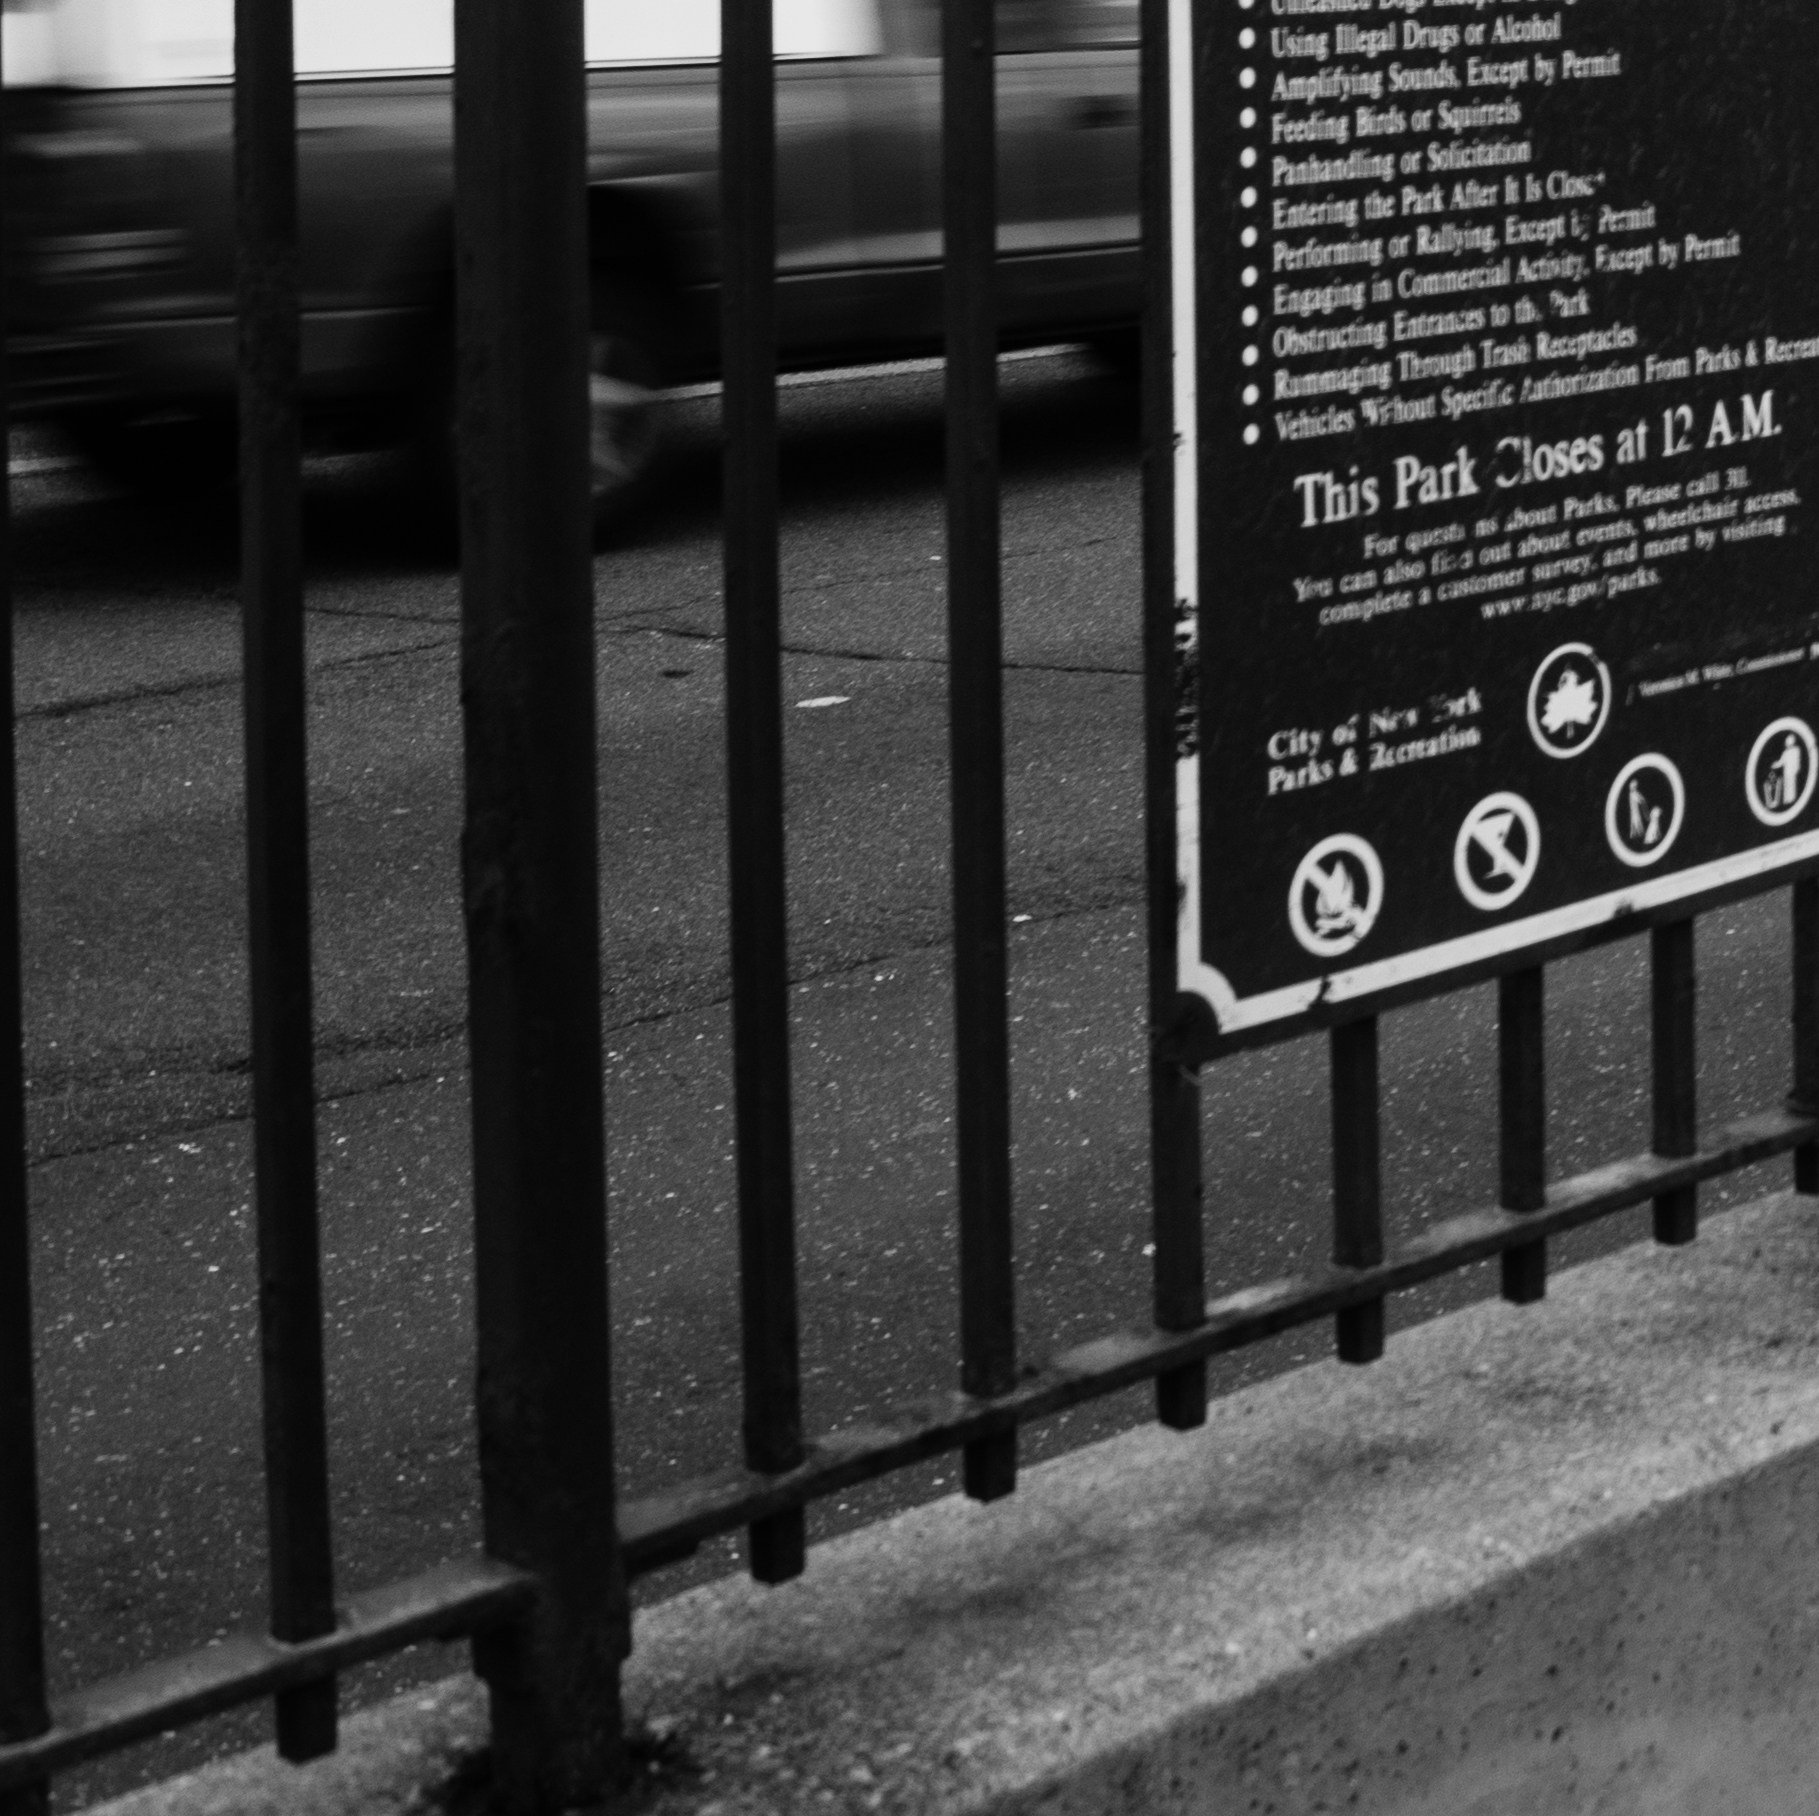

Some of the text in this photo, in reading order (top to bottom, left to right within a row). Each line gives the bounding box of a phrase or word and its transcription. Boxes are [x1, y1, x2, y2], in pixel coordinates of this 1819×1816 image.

[1270, 12, 1561, 60] Using Illegal Drugs or Alcohol
[1271, 96, 1521, 144] Feeding Birds or Squirrels
[1293, 465, 1379, 527] This
[1394, 445, 1479, 509] Park
[1616, 420, 1647, 463] at
[1662, 404, 1693, 456] 12
